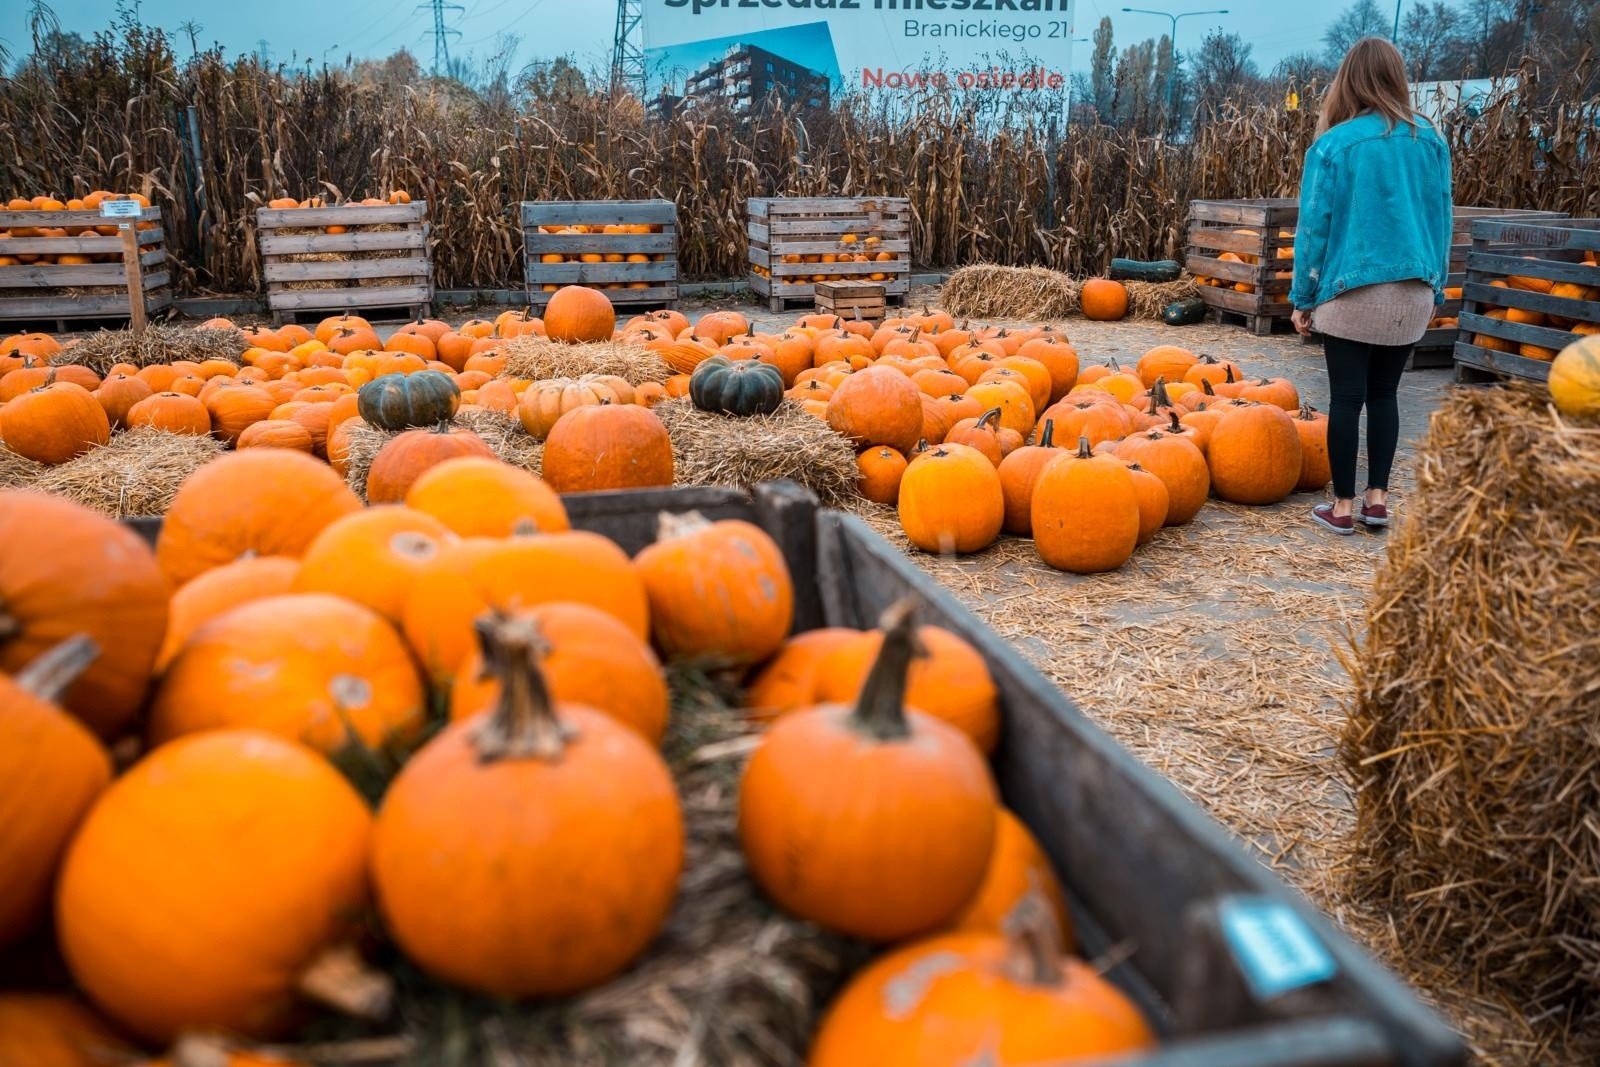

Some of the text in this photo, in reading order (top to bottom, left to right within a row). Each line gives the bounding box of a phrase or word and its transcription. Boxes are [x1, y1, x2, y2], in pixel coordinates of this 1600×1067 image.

[904, 19, 1067, 42] Branickiego 21
[863, 65, 1064, 89] Nowe osiedle
